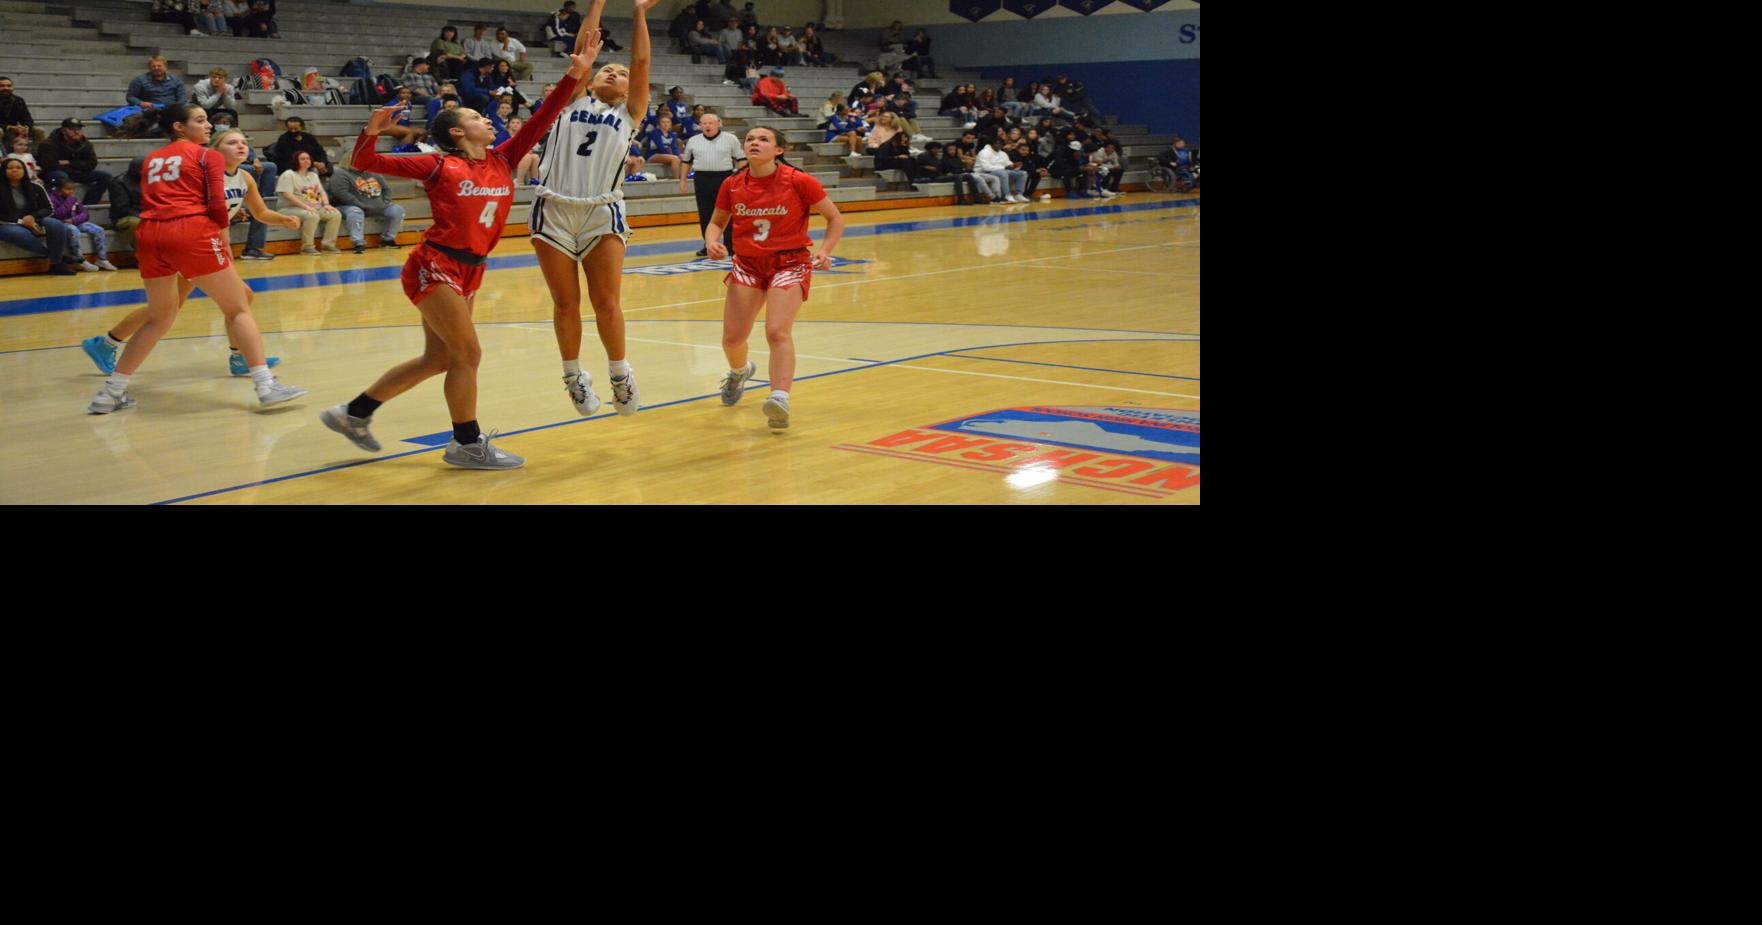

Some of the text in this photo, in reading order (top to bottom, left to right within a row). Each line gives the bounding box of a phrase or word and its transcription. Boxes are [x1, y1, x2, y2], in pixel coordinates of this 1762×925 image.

[1178, 23, 1200, 44] S
[575, 130, 598, 157] 2
[147, 155, 182, 185] 23
[478, 201, 499, 228] 4
[734, 202, 788, 217] Bearcats
[752, 218, 771, 242] 3
[868, 428, 1200, 491] NCHSAA
